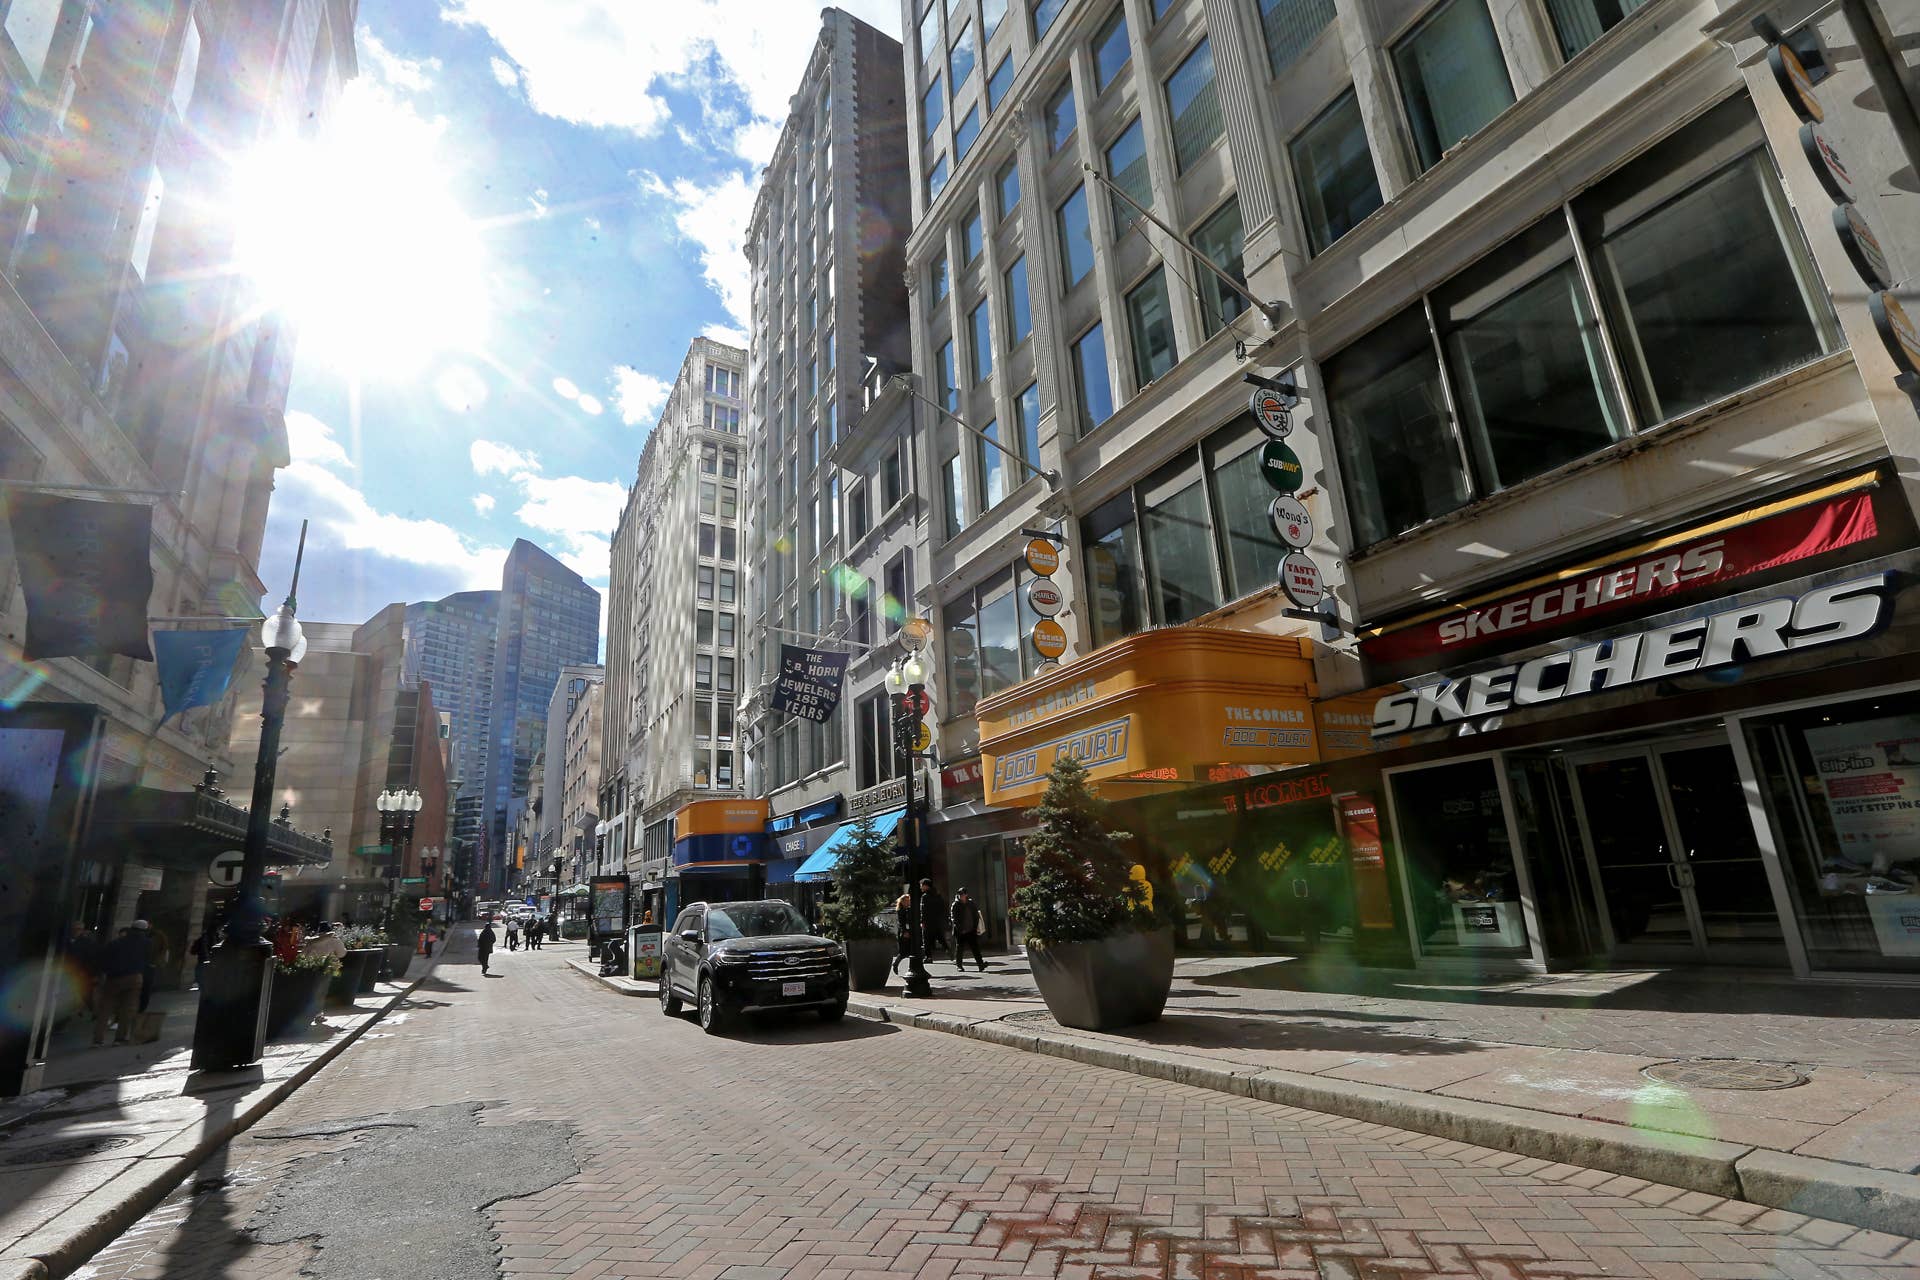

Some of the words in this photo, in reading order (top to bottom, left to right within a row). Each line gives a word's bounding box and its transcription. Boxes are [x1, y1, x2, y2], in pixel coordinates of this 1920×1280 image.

[1268, 458, 1300, 473] SUBWAY
[1276, 507, 1309, 525] Wong's
[1286, 562, 1317, 577] TASTY
[1294, 575, 1314, 589] BBQ
[1438, 539, 1726, 645] SKECHERS
[806, 653, 823, 663] THE
[1369, 572, 1886, 738] SKECHERS
[808, 664, 839, 677] HORN
[780, 678, 837, 703] JEWELERS
[794, 693, 819, 706] 185
[1007, 703, 1034, 728] THE
[1036, 679, 1097, 716] CORNER
[785, 699, 824, 720] YEARS
[1224, 706, 1251, 721] THE
[1252, 707, 1304, 722] CORNER
[1223, 727, 1257, 746] FOOD
[1266, 731, 1308, 747] COURT
[992, 752, 1038, 793] FOOD
[1055, 727, 1124, 762] COURT
[953, 767, 970, 784] THE
[850, 796, 864, 811] THE
[880, 782, 906, 801] HORN
[1835, 804, 1865, 814] JUST
[1866, 802, 1896, 812] STEP
[1898, 800, 1913, 810] IN
[785, 840, 800, 852] CHASE
[217, 861, 244, 881] T
[648, 872, 658, 881] T
